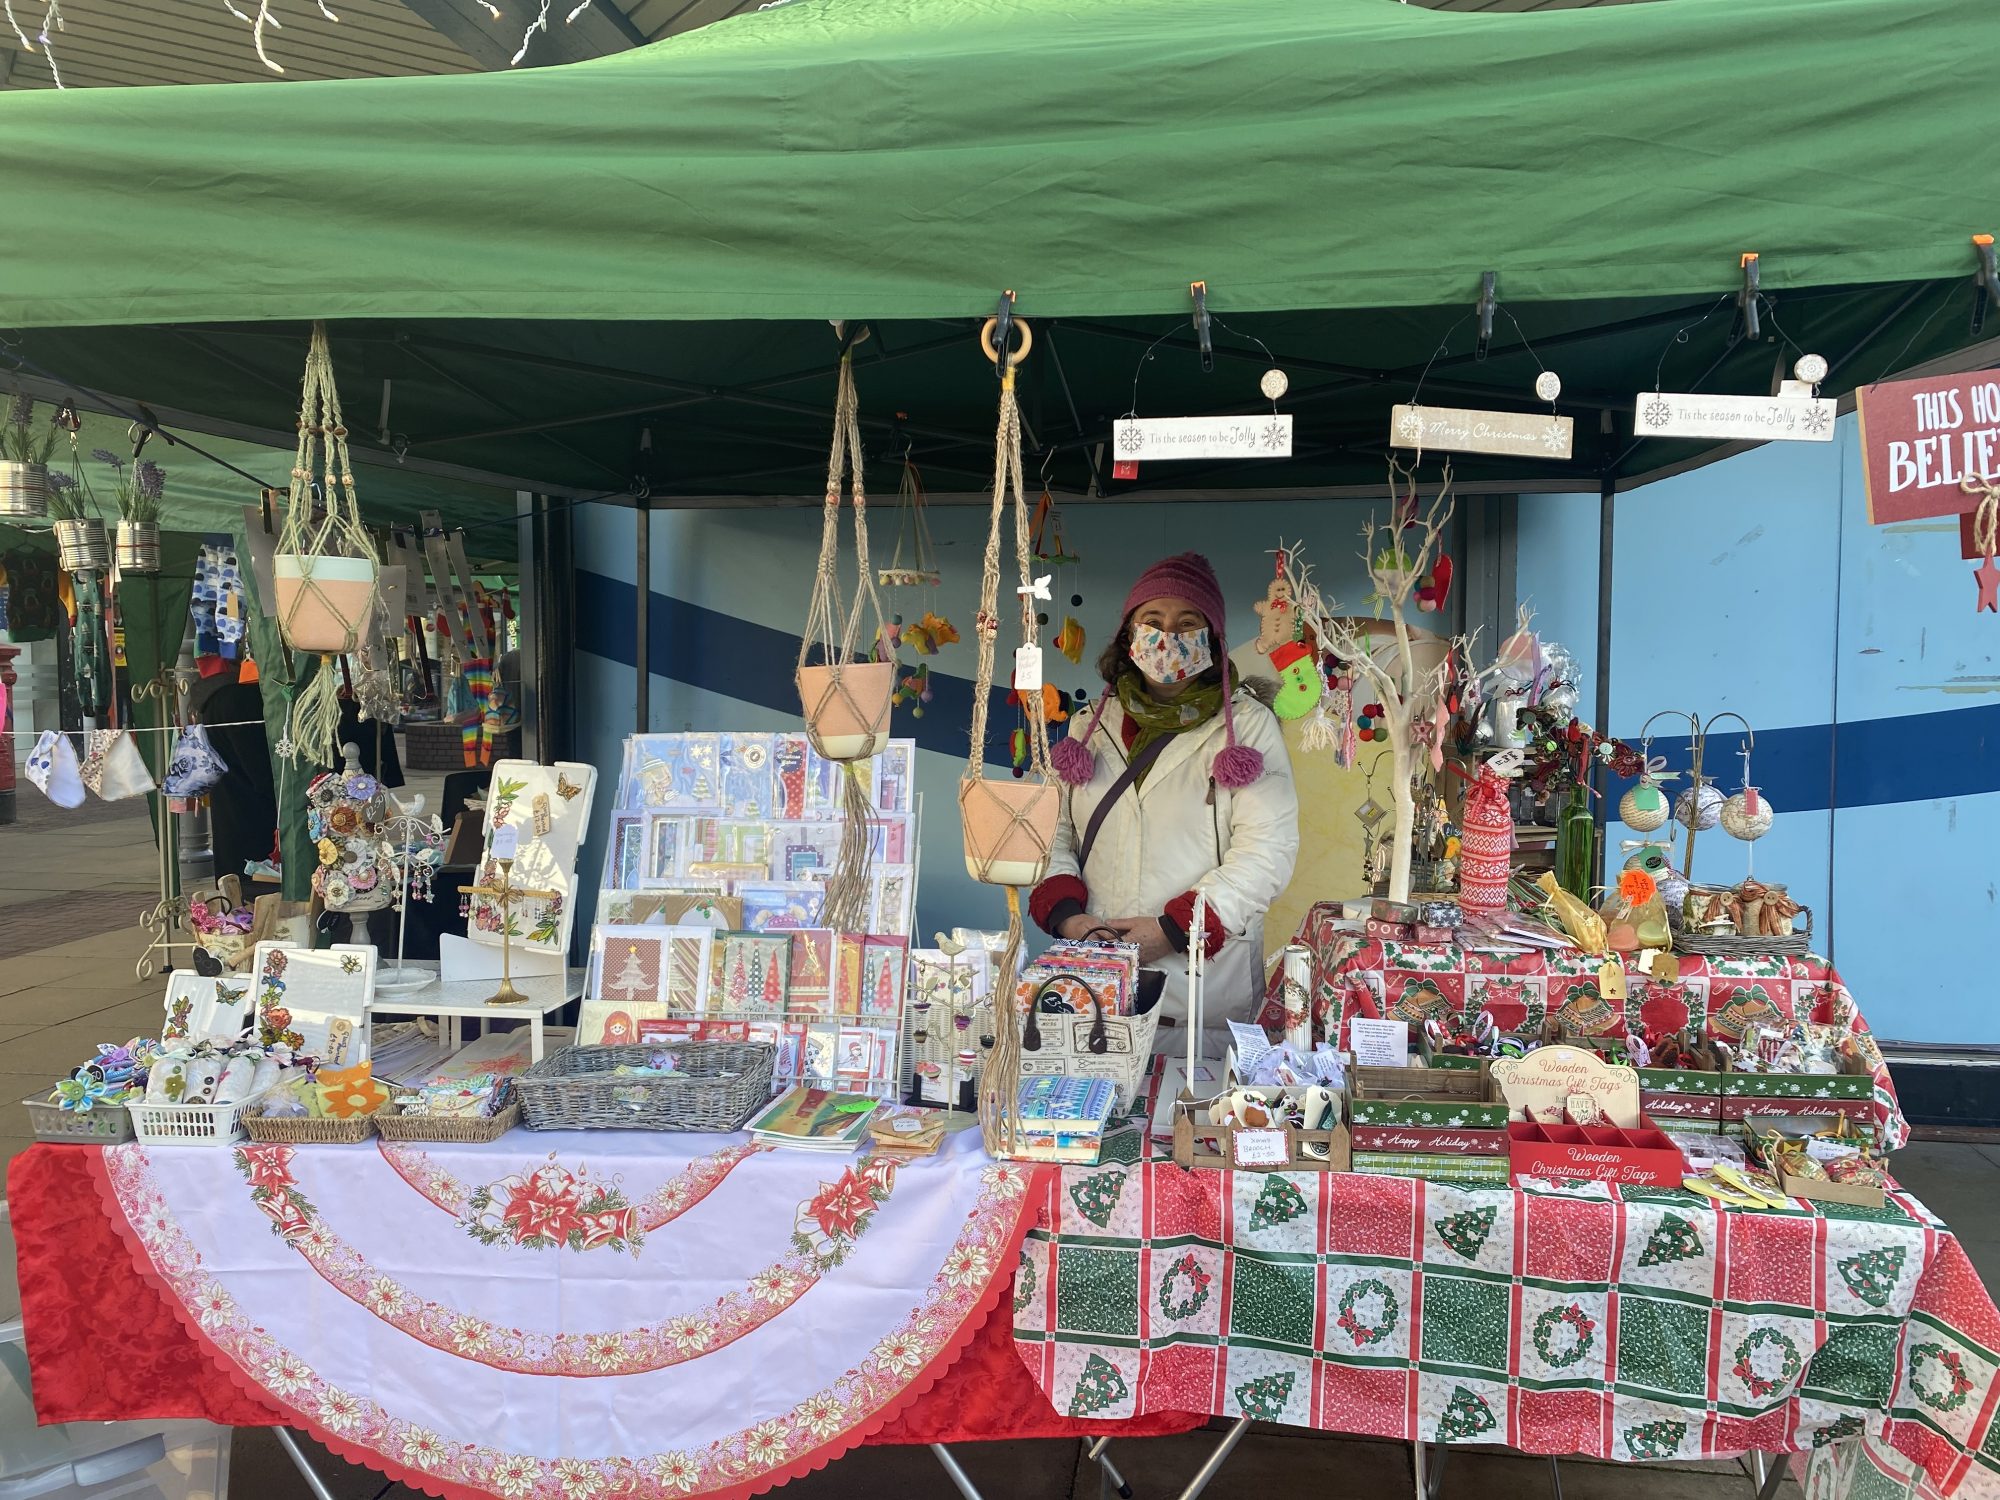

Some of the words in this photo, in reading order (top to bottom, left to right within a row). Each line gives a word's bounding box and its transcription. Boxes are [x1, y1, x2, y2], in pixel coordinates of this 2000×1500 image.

[1912, 388, 1964, 432] THIS
[1971, 382, 2000, 424] HO
[1694, 409, 1706, 421] the
[1710, 411, 1741, 421] season
[1744, 413, 1753, 422] to
[1755, 411, 1766, 423] be
[1767, 406, 1796, 430] Jolly
[1163, 432, 1177, 444] the
[1178, 434, 1207, 443] season
[1209, 434, 1217, 443] to
[1219, 431, 1229, 443] be
[1230, 426, 1256, 448] Jolly
[1429, 421, 1471, 440] Merry
[1473, 422, 1538, 441] Christmas
[1888, 427, 2000, 492] BELIE
[1539, 1059, 1589, 1074] Wooden
[1507, 1072, 1563, 1088] Christmas
[1565, 1076, 1587, 1090] Gift
[1589, 1076, 1622, 1092] Tags
[1570, 1100, 1590, 1109] HAVE
[1645, 1099, 1684, 1113] Holiday
[1757, 1104, 1790, 1117] Happy
[1388, 1133, 1422, 1149] Happy
[1428, 1135, 1470, 1150] Holiday
[1567, 1147, 1622, 1163] Wooden
[1531, 1161, 1593, 1177] Christmas
[1596, 1165, 1619, 1182] Gift
[1623, 1166, 1658, 1184] Tags
